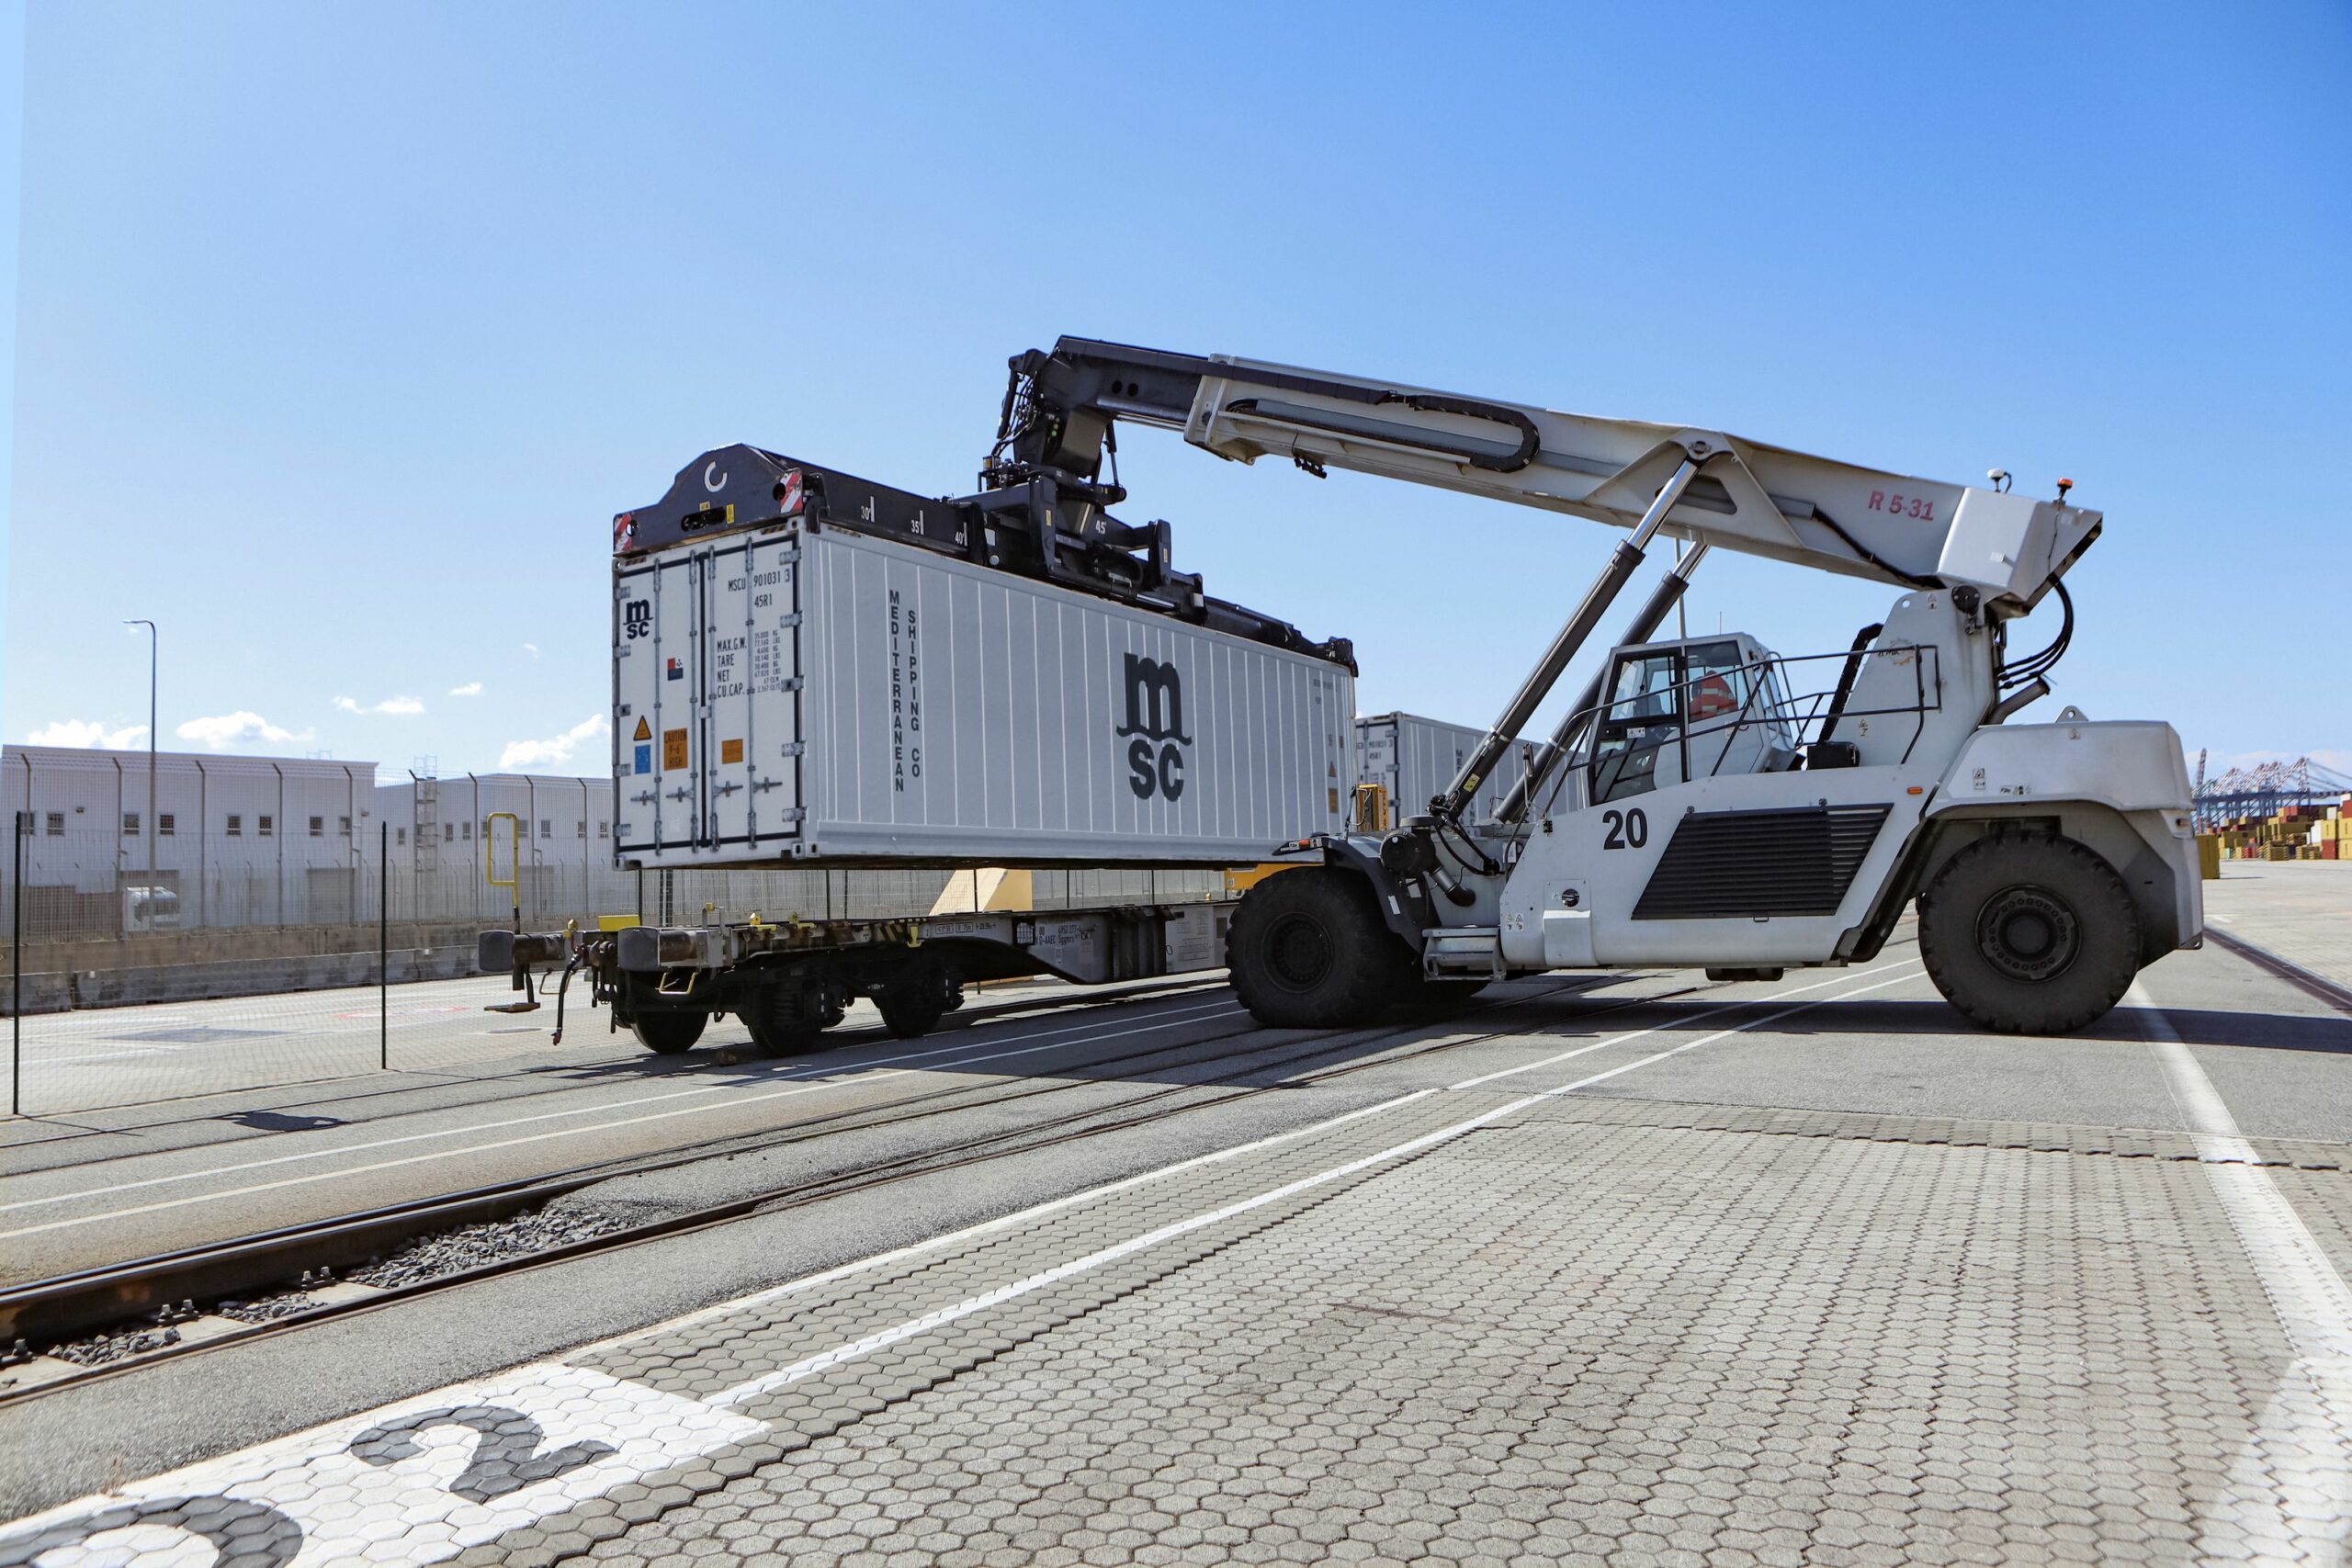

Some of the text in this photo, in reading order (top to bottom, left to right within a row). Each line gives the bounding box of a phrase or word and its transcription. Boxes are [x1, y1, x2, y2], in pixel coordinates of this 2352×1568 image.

[1868, 490, 1884, 512] R
[728, 568, 791, 592] MSCU 901031 3
[753, 592, 773, 608] 45R1
[718, 653, 735, 669] TARE
[717, 669, 729, 682] NET
[889, 589, 904, 792] MEDITERRANEAN
[908, 609, 921, 778] SHIPPING CO
[1602, 807, 1648, 850] 20
